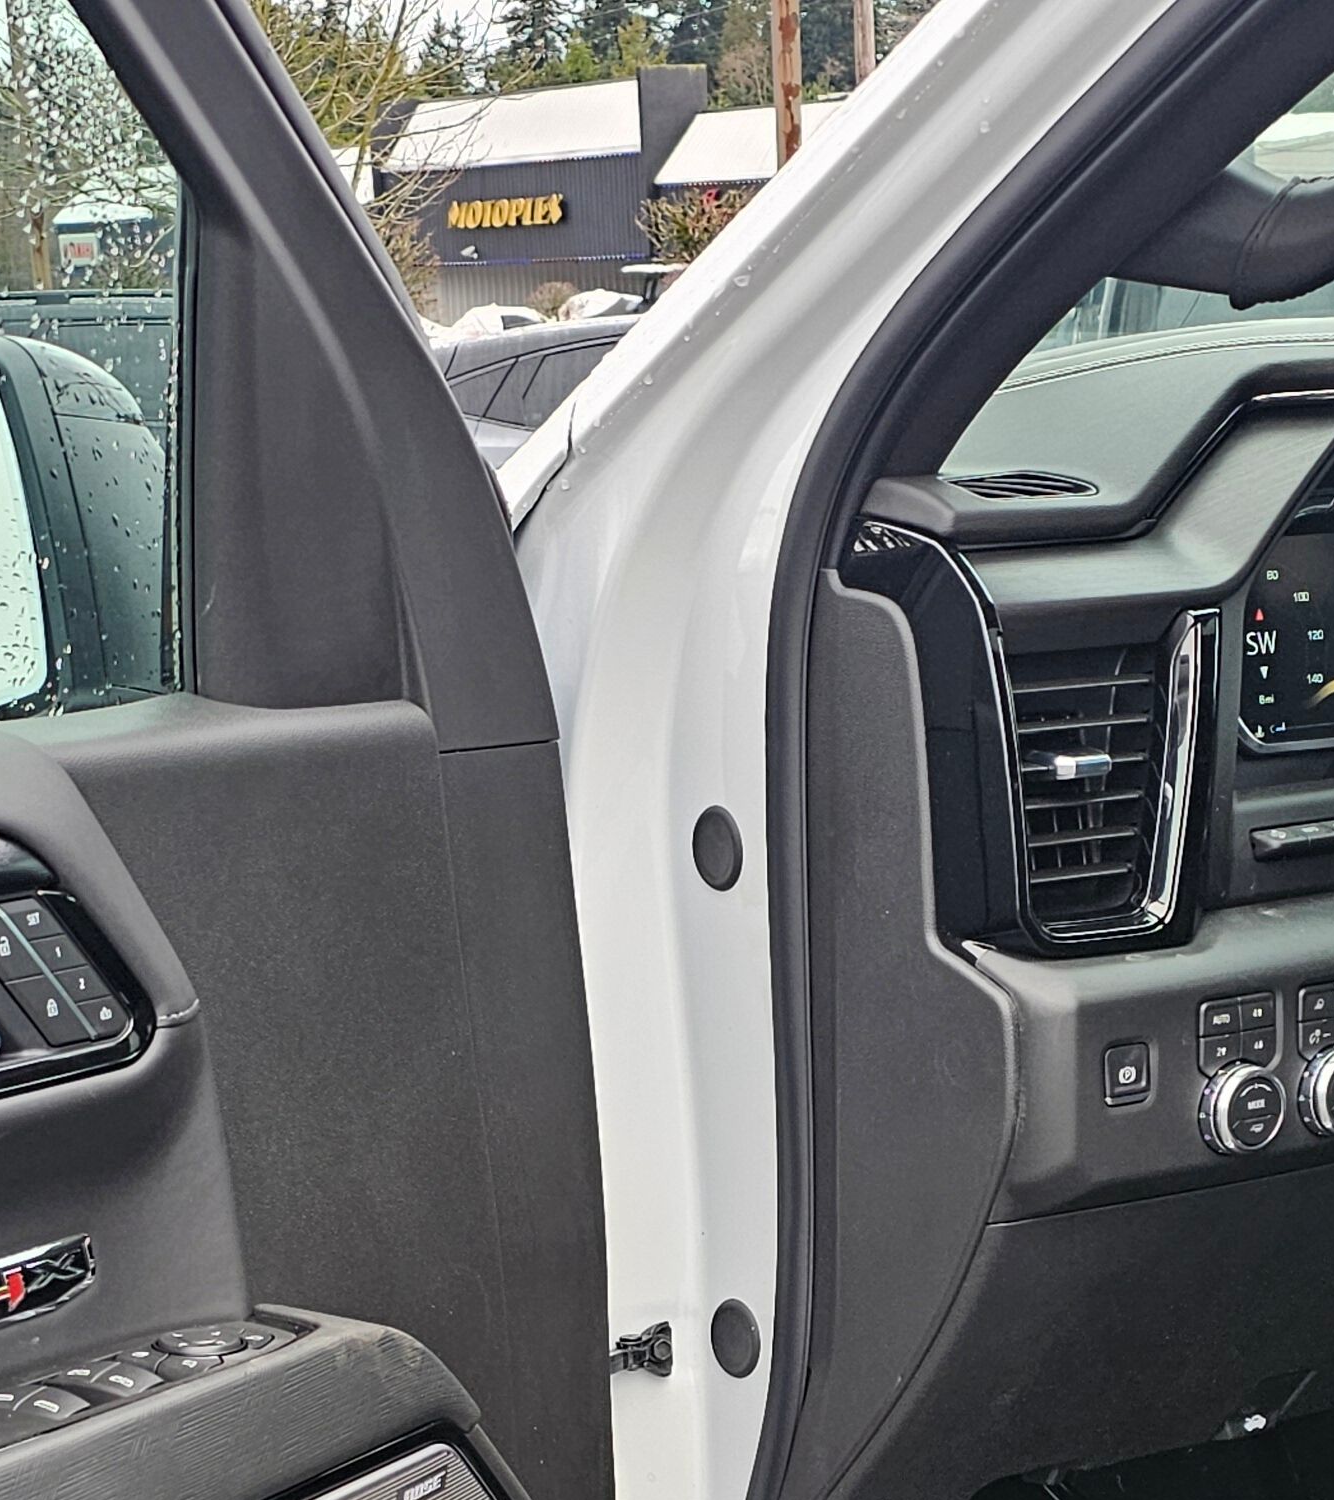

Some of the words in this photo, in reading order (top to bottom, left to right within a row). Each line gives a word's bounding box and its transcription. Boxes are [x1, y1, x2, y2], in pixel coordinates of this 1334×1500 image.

[447, 193, 563, 229] MOTOPLEX
[1307, 629, 1324, 641] 120
[1246, 630, 1277, 656] SW
[1306, 673, 1324, 684] 140
[55, 946, 62, 958] 1
[78, 978, 86, 990] 2
[1213, 1013, 1231, 1025] AUTO
